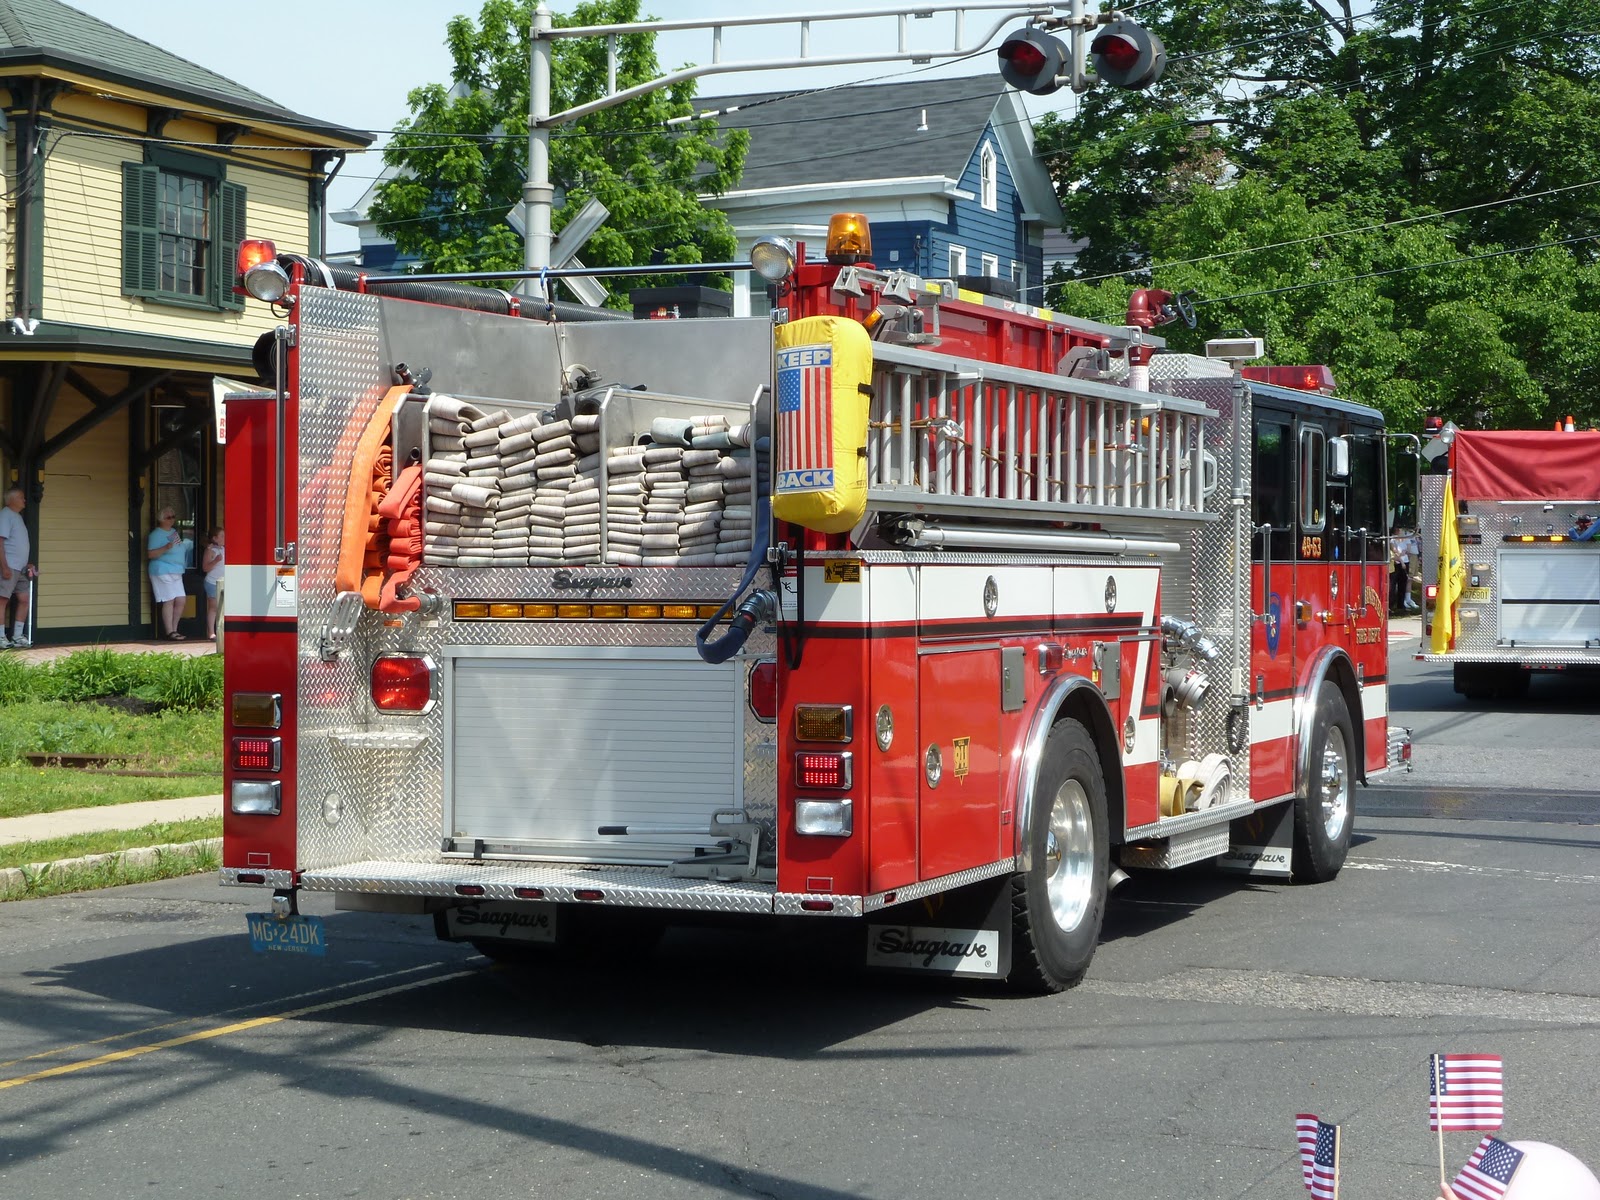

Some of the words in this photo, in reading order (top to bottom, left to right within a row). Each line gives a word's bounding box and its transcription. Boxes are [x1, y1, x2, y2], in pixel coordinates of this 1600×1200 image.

[777, 350, 831, 369] KEEP
[777, 471, 832, 488] BACK
[552, 570, 633, 597] Seagrave
[1223, 846, 1286, 867] Seagrave
[456, 905, 549, 936] Seagrave
[877, 929, 988, 967] Seagrave
